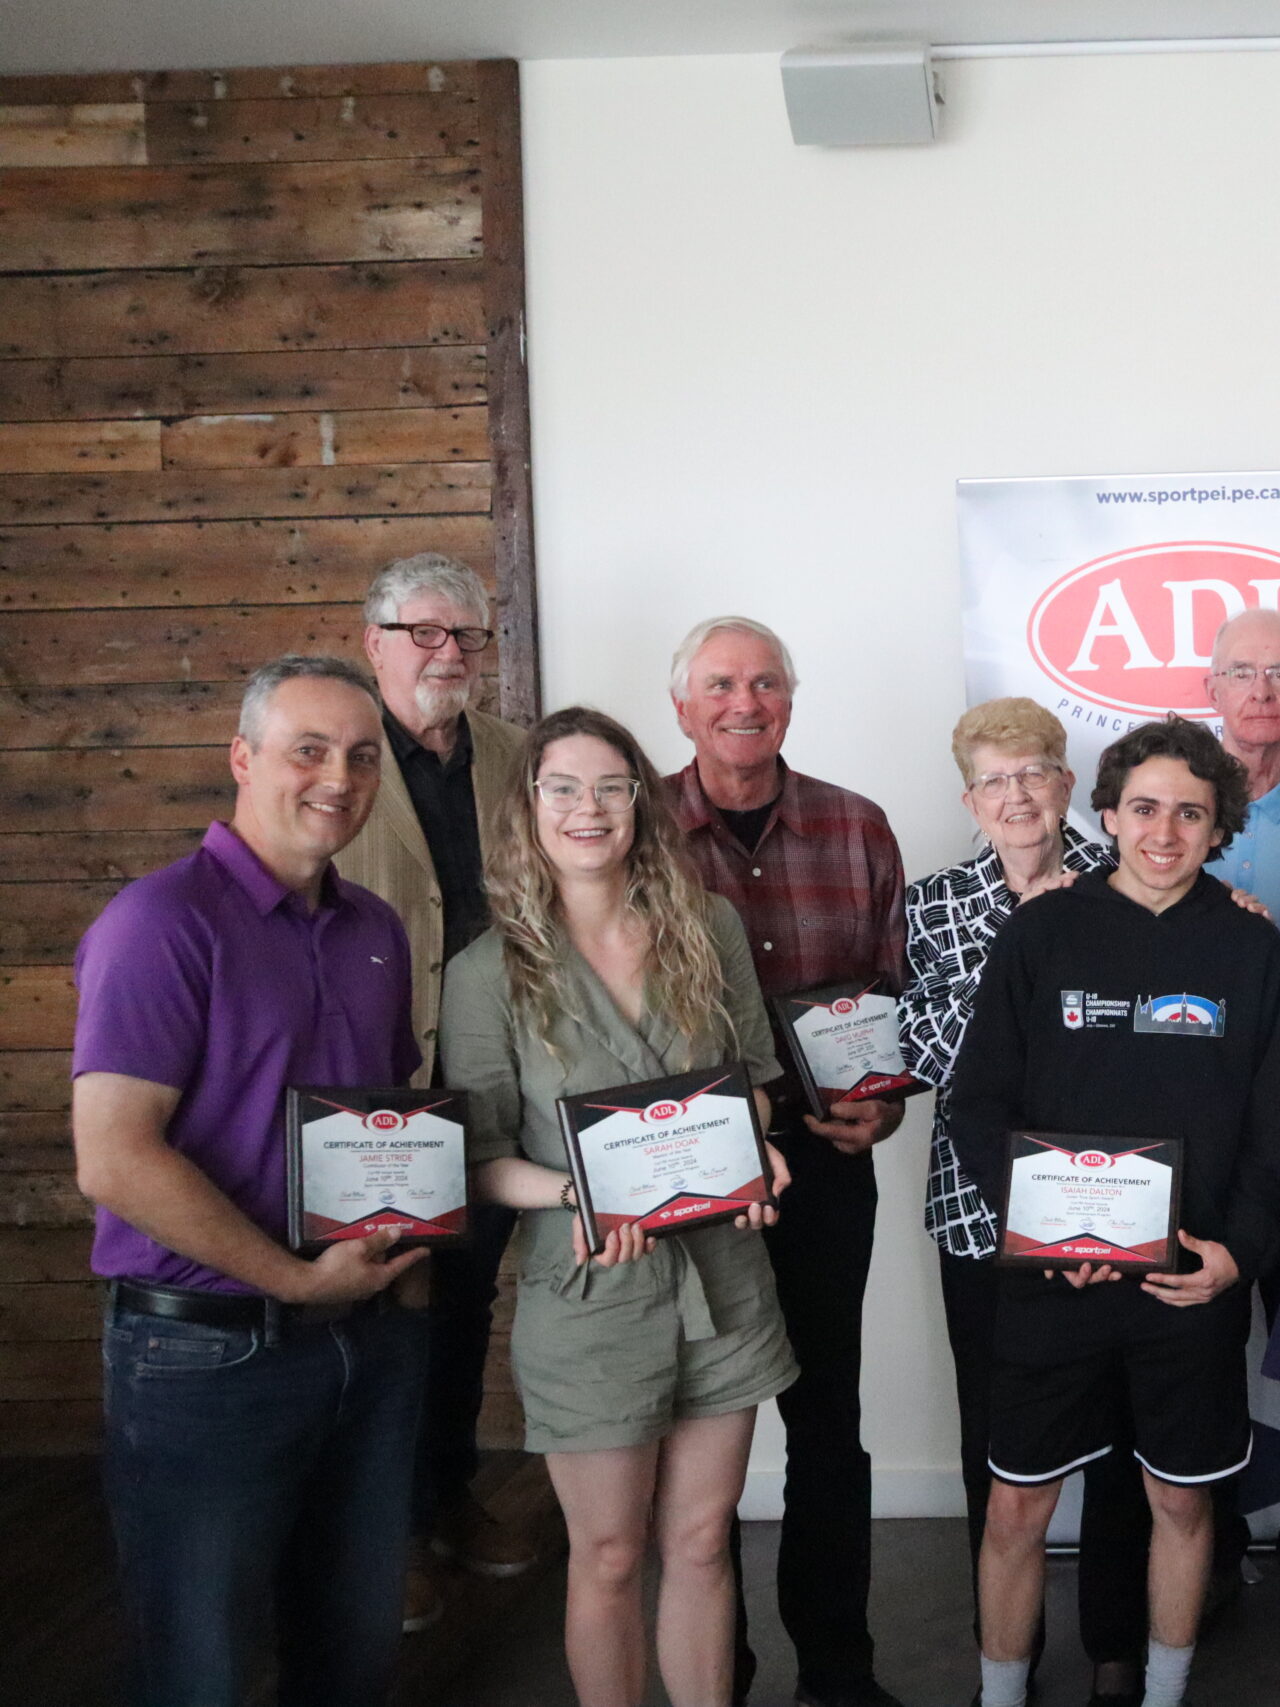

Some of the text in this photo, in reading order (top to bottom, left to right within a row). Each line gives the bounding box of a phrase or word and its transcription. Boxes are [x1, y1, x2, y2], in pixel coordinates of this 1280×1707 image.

[1096, 486, 1280, 505] www.sportpei.pe.ca
[653, 1106, 675, 1118] ADL
[374, 1115, 398, 1126] ADL
[604, 1117, 730, 1151] CERTIFICATE OF ACHIEVEMENT
[323, 1140, 444, 1149] CERTIFICATE OF ACHIEVEMENT
[644, 1144, 672, 1156] SARAH
[359, 1153, 413, 1162] JAMIE STRIDE
[1082, 1155, 1104, 1166] ADL
[1031, 1174, 1079, 1182] CERTIFICATE
[1094, 1177, 1151, 1186] ACHIEVEMENT
[1061, 1187, 1122, 1196] ISAIAH DALTON
